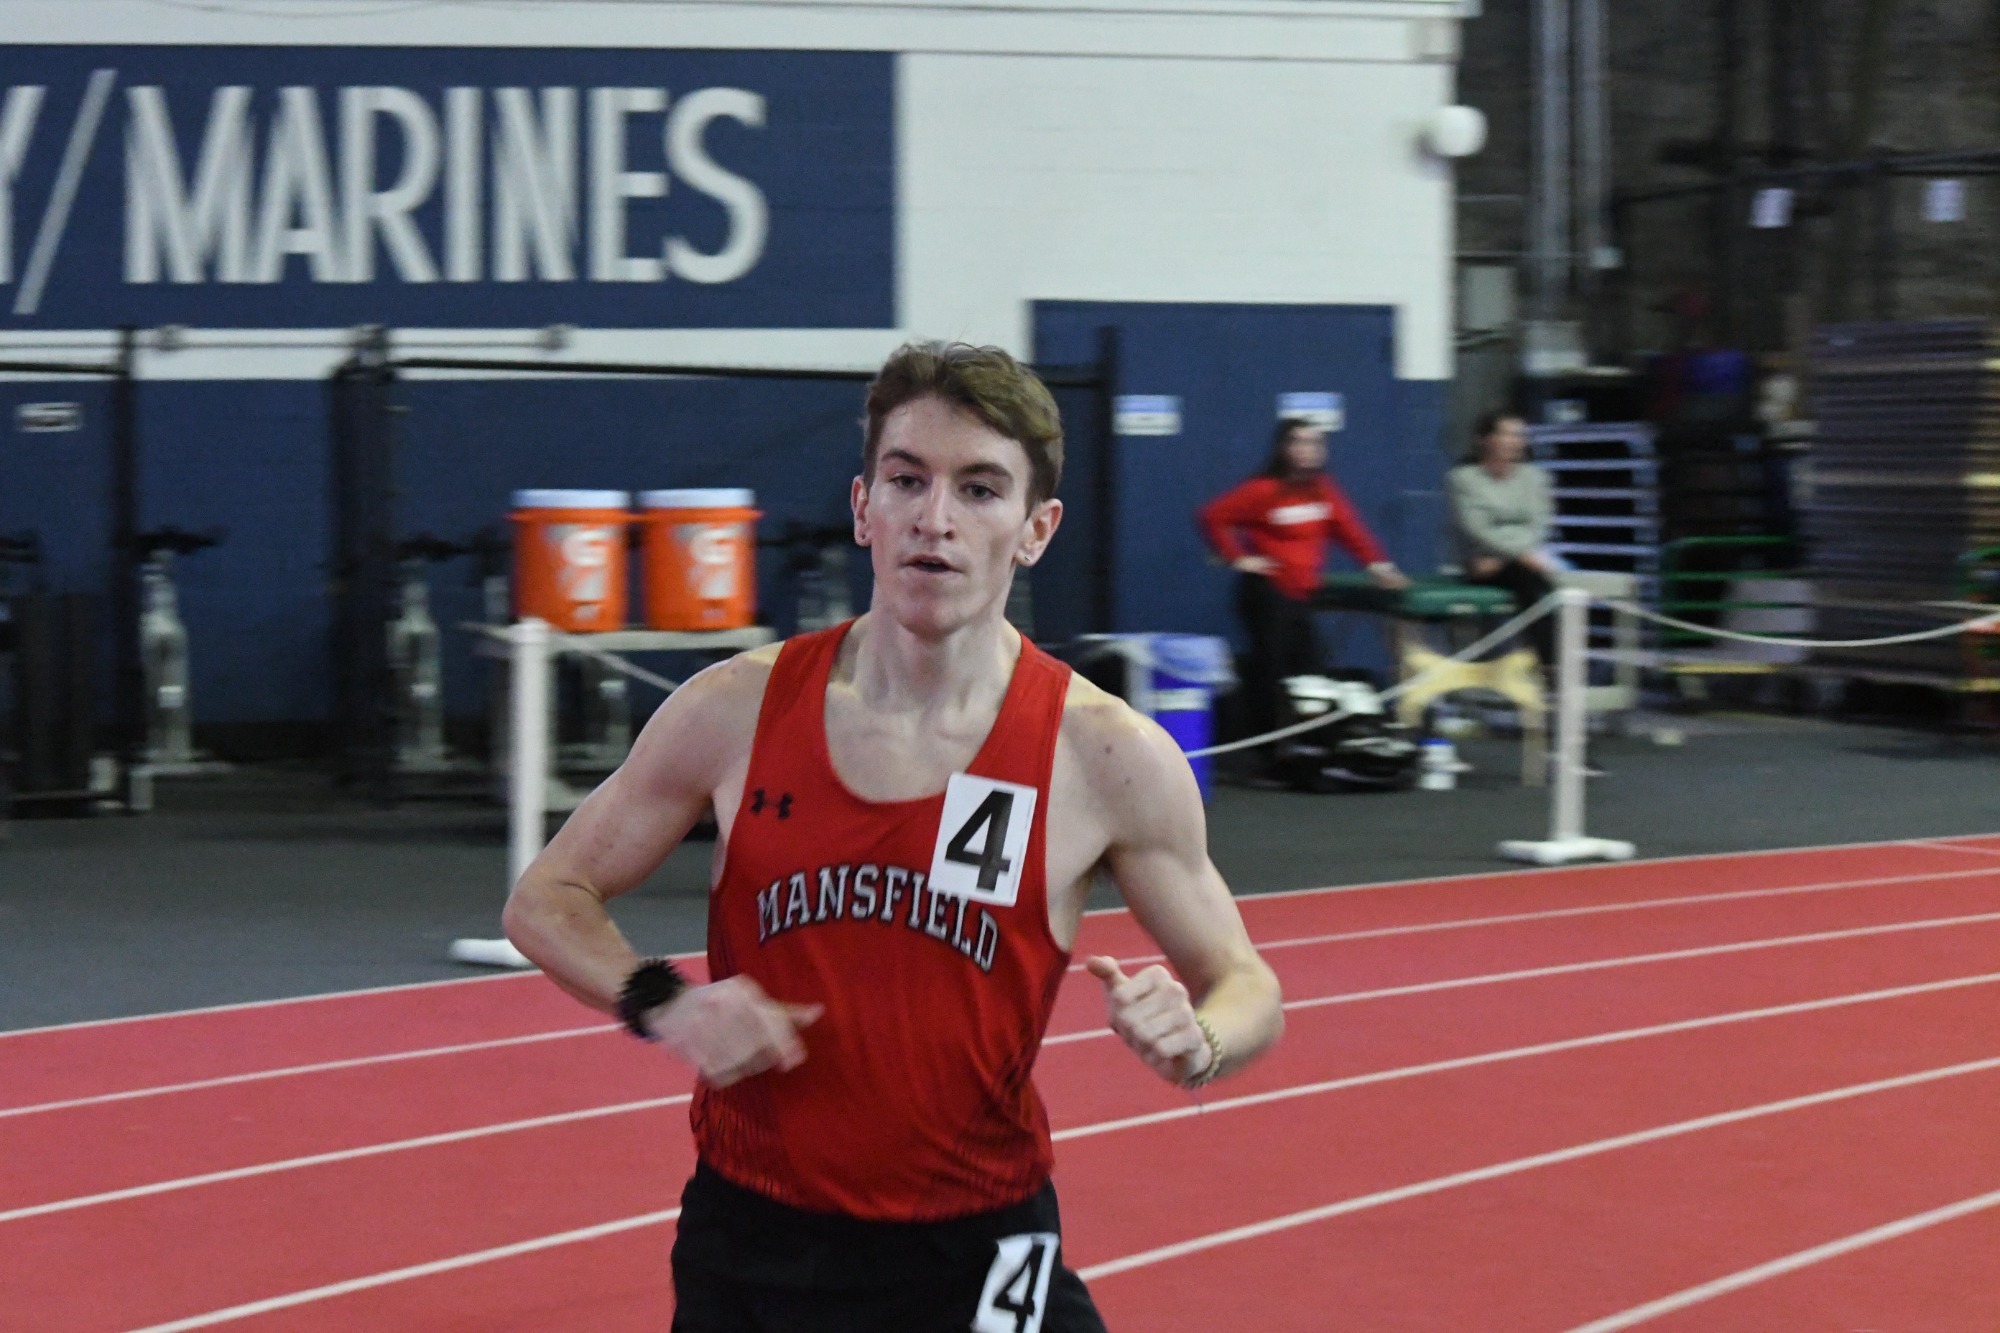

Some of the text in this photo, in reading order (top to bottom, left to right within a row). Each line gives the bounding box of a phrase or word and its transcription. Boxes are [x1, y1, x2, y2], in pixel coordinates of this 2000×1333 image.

[944, 789, 1015, 893] 4
[756, 863, 999, 972] MANSFIELD
[993, 1238, 1046, 1333] 4
